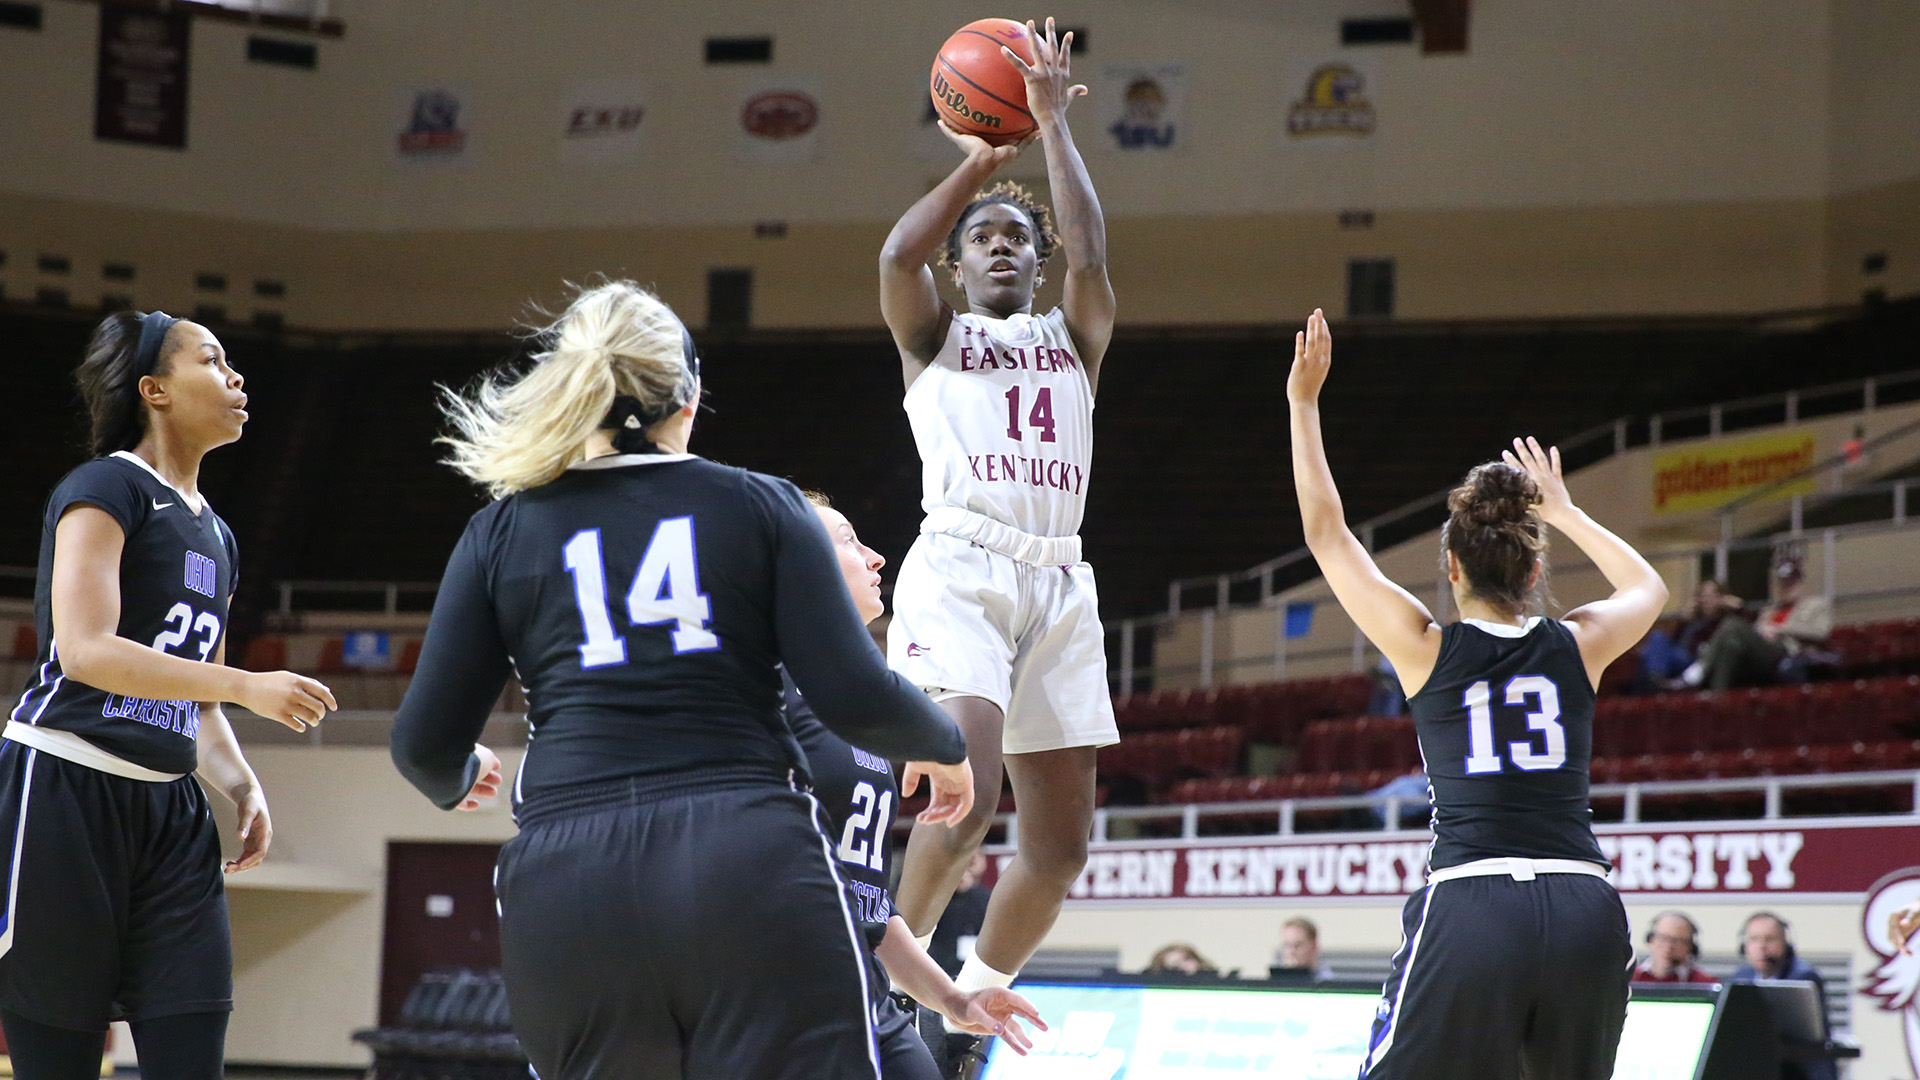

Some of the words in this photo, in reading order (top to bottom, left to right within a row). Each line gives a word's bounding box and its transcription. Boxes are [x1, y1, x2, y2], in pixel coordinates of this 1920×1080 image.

[934, 69, 1001, 128] Wilson
[960, 346, 1077, 374] EASTERN
[1005, 385, 1056, 443] 14
[968, 454, 1083, 495] KENTUCKY
[184, 550, 216, 598] OHIO
[562, 515, 722, 671] 14
[153, 601, 221, 664] 23
[1462, 674, 1567, 775] 13
[840, 780, 893, 872] 21
[1184, 843, 1431, 895] KENTUCKY
[1597, 832, 1803, 890] ERSITY
